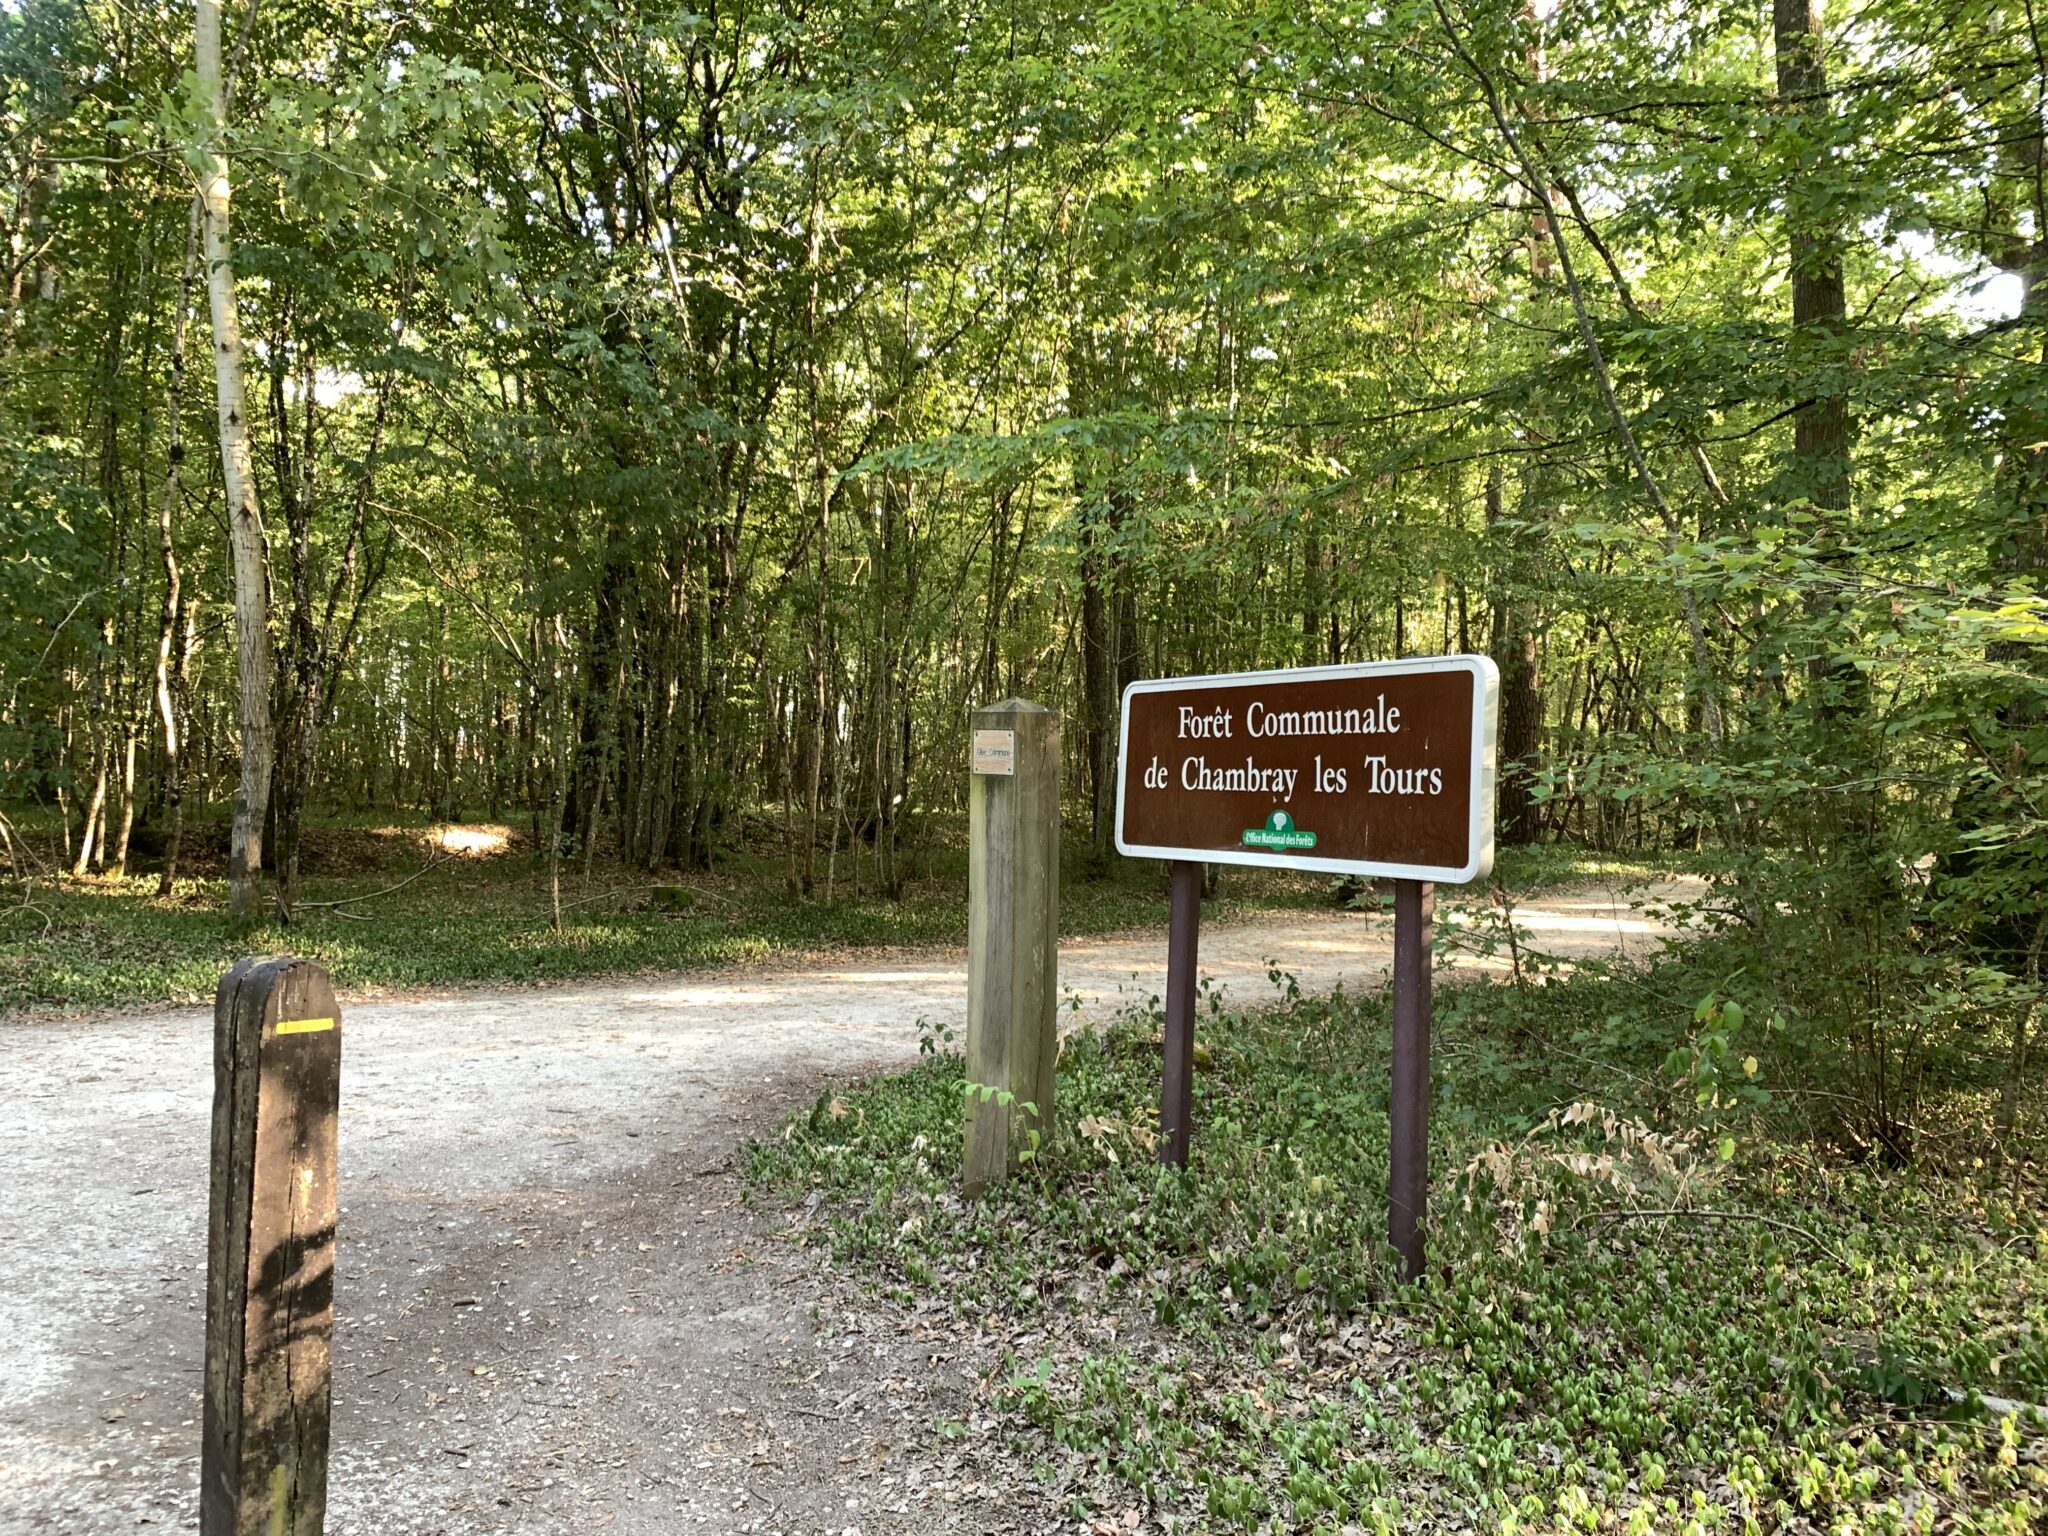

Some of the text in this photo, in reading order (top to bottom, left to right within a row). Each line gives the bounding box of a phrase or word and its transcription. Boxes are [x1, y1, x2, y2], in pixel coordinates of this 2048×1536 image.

[1178, 694, 1400, 739] Forêt Communale
[1144, 755, 1442, 802] de Chambray les Tours
[1262, 832, 1285, 844] National
[1286, 834, 1295, 845] des
[1296, 834, 1314, 846] Forêts
